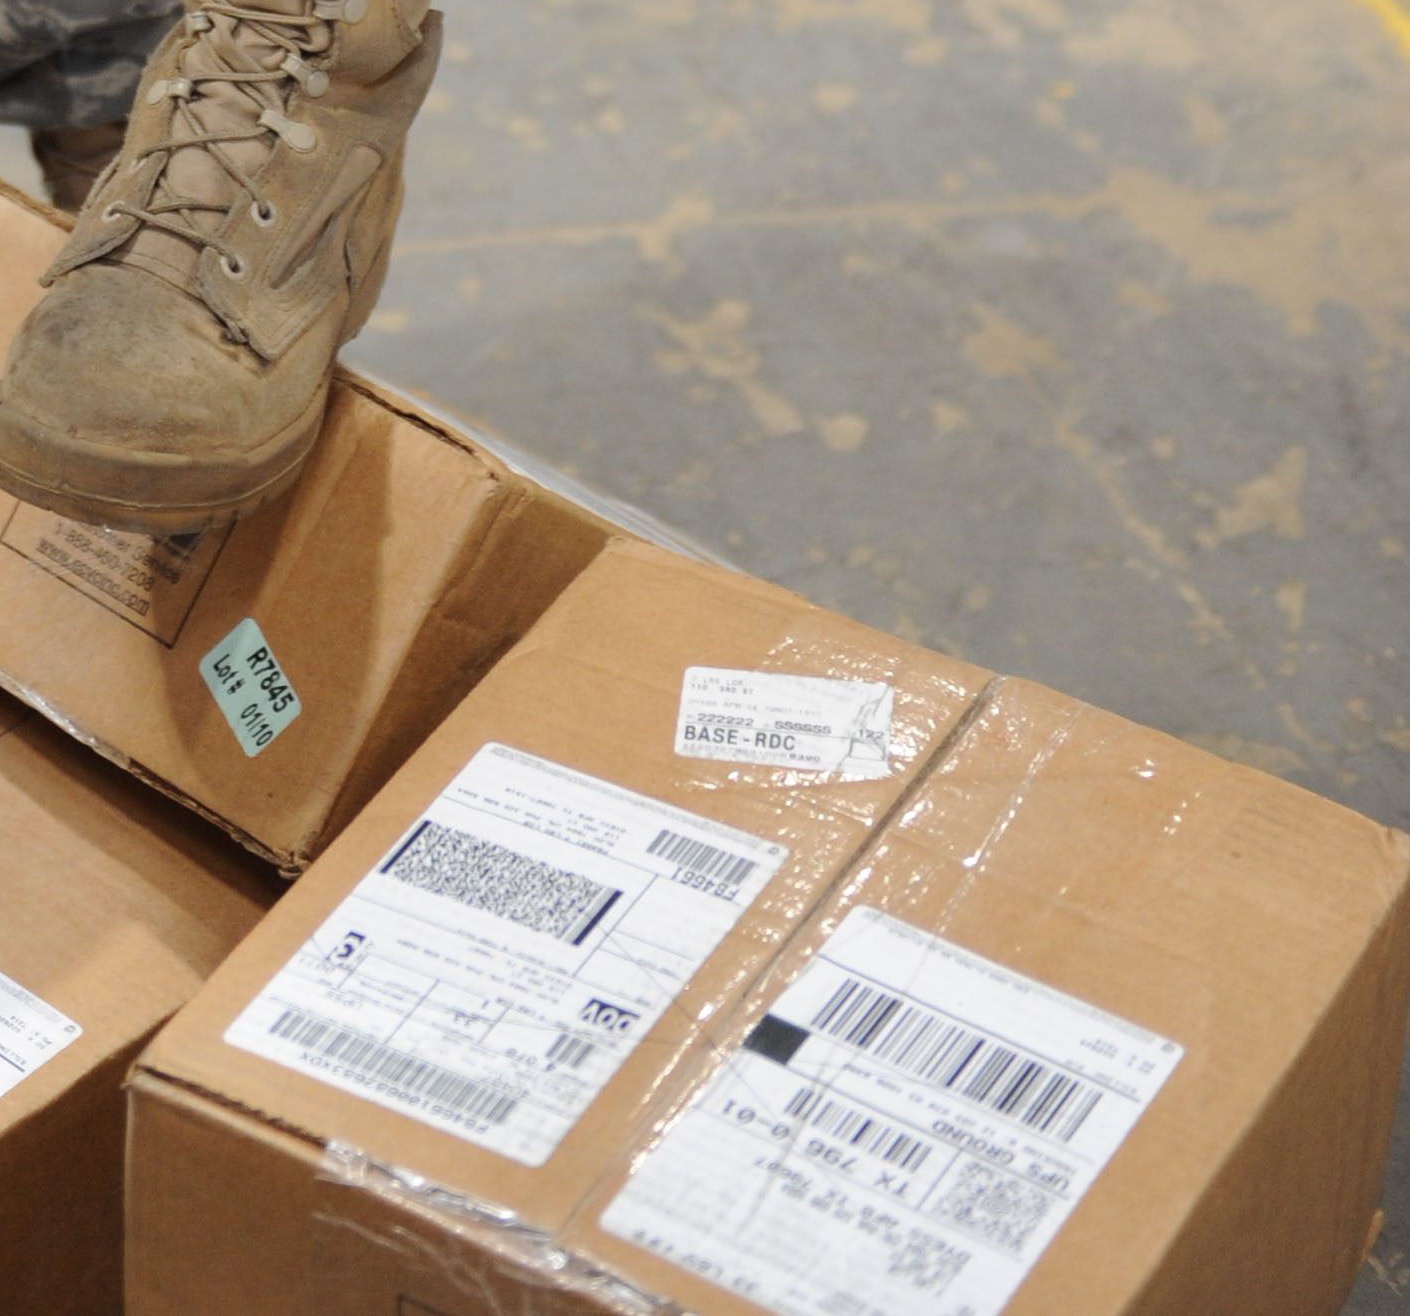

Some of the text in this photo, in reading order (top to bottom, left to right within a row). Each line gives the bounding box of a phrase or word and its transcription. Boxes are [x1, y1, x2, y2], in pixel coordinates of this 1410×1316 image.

[213, 653, 239, 685] Lot
[246, 646, 295, 713] R7845
[667, 865, 742, 901] FB4661
[574, 996, 641, 1037] DOV
[797, 1135, 864, 1174] 796
[924, 1116, 1074, 1191] UPS GROUND
[867, 1167, 917, 1199] TX
